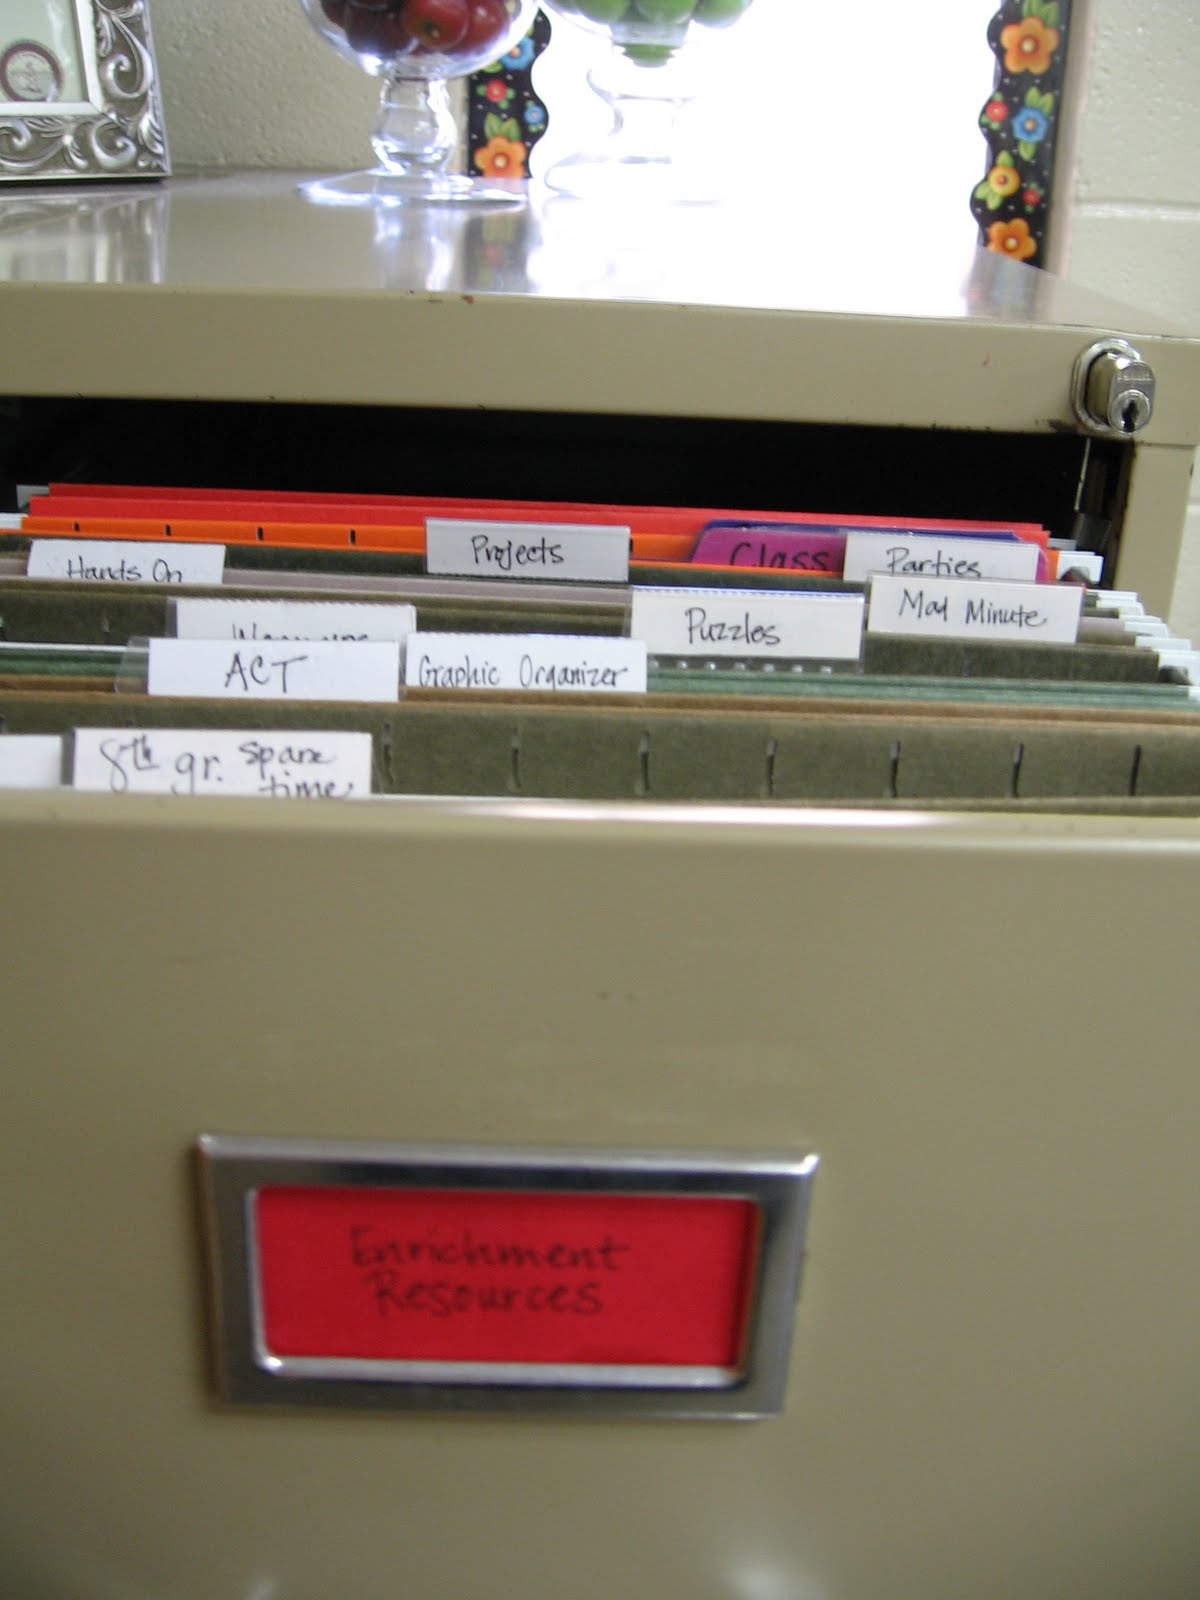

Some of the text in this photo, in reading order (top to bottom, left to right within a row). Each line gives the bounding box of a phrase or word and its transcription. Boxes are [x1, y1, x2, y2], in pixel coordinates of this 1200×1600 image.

[67, 555, 182, 583] Hands On
[471, 534, 564, 571] Projects
[729, 542, 830, 572] Class
[885, 547, 982, 579] Parties
[685, 607, 781, 646] Puzzles
[965, 600, 1047, 629] Minute
[224, 652, 308, 693] ACT
[419, 653, 628, 690] Graphic Organizer
[171, 752, 223, 795] gr.
[349, 1225, 630, 1271] Enrichment
[361, 1269, 603, 1319] Resources
